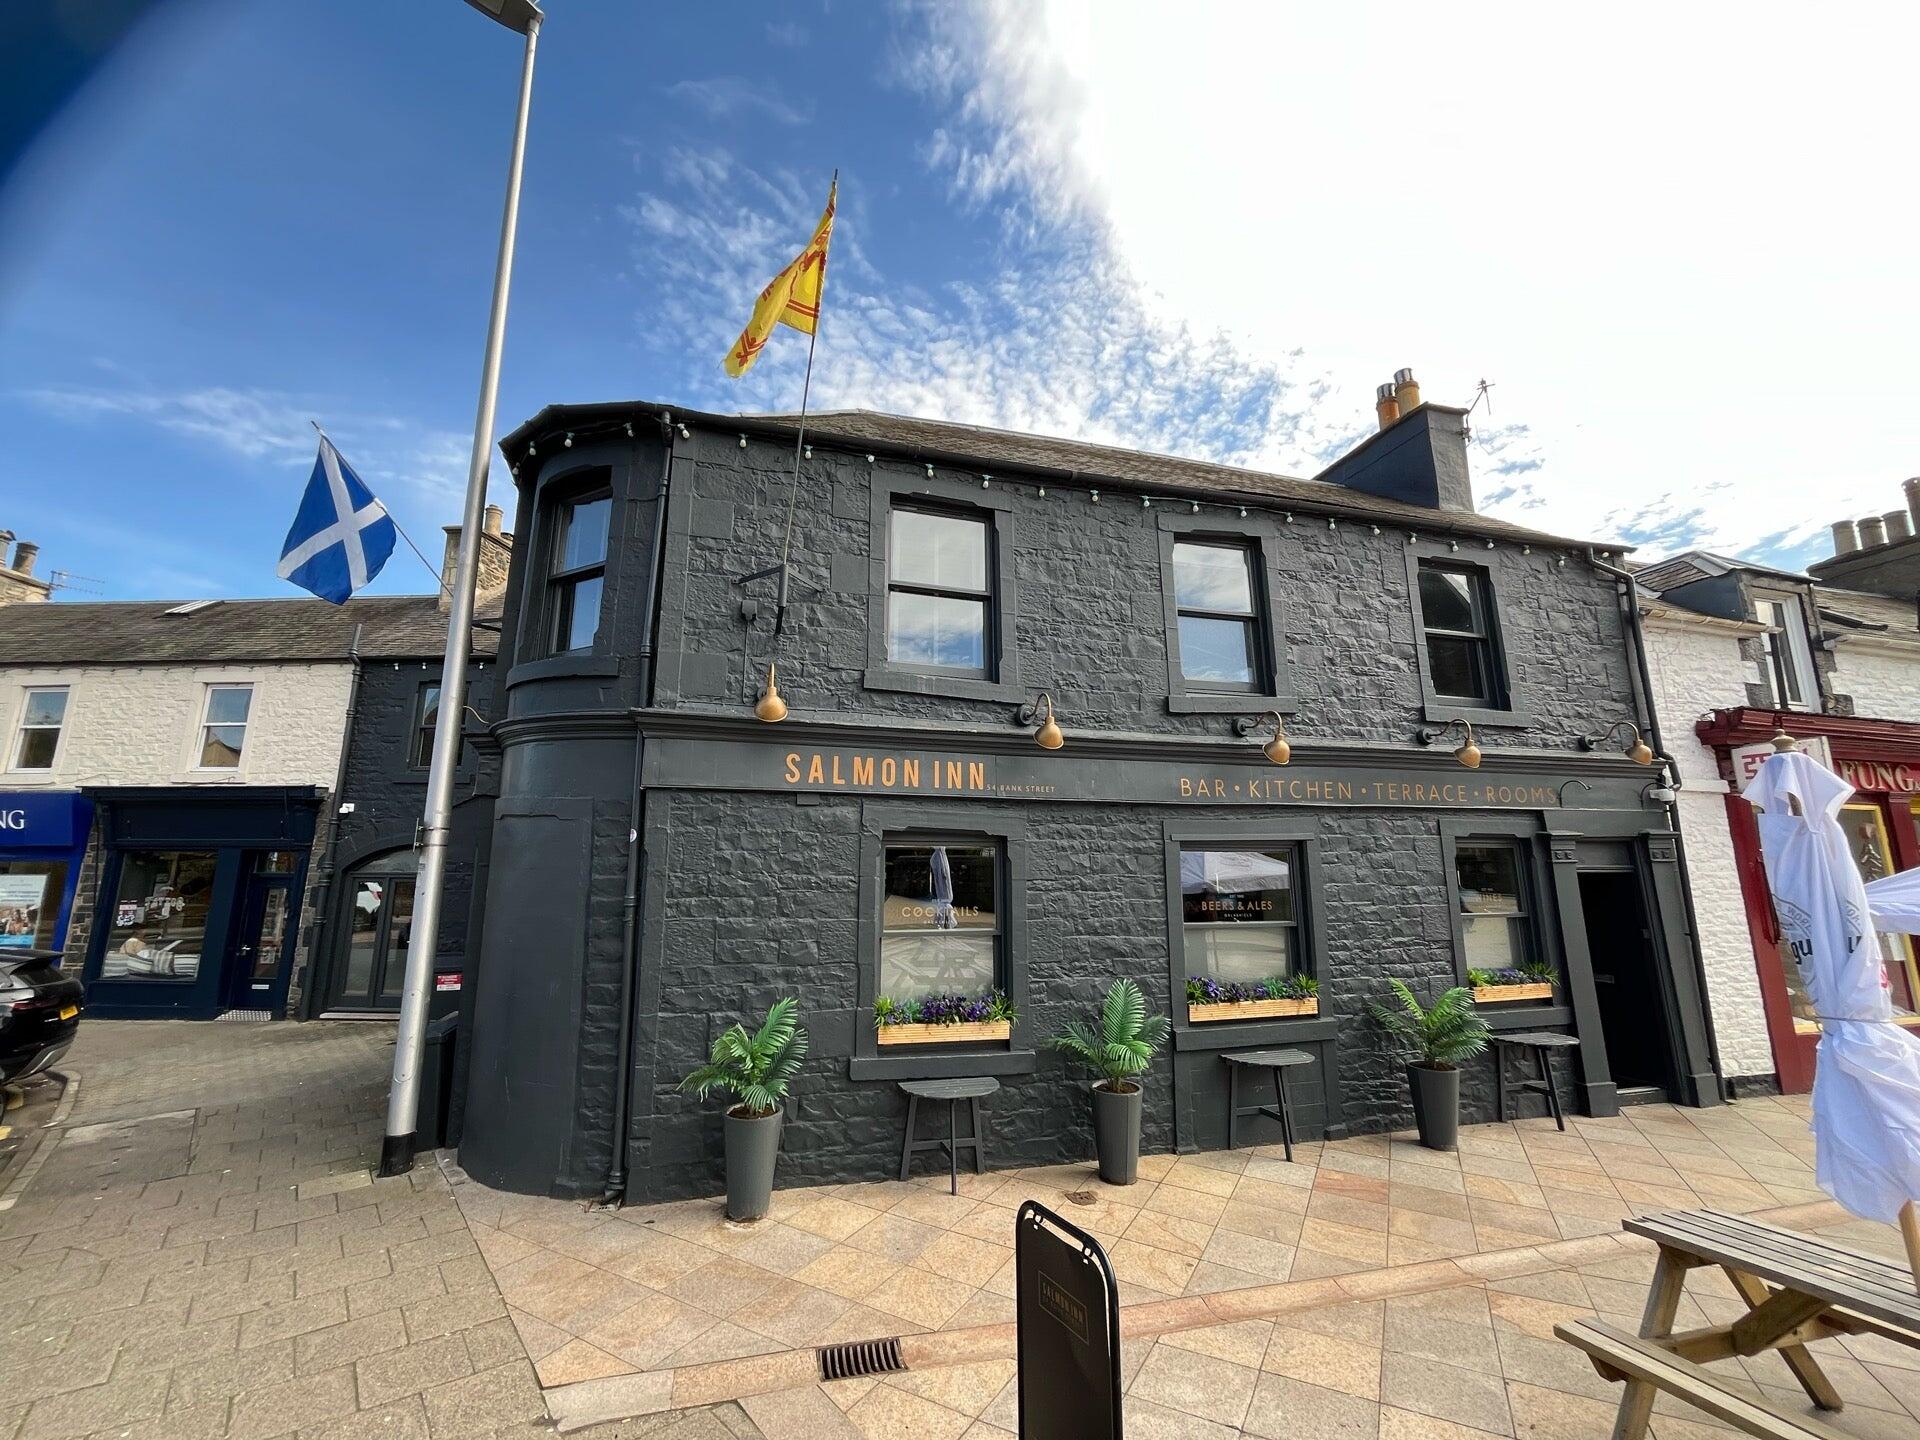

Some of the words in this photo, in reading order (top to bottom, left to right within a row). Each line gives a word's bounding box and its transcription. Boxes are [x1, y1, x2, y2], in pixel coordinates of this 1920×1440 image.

[784, 752, 920, 788] SALMON
[933, 759, 985, 791] INN
[1837, 759, 1914, 791] FUNG
[986, 783, 996, 791] 54
[1000, 784, 1023, 792] BANK
[1024, 785, 1056, 793] STREET
[1180, 778, 1226, 797] BAR
[1249, 779, 1352, 799] KITCHEN
[1372, 782, 1468, 802] TERRACE
[1486, 785, 1556, 804] ROOMS
[1201, 901, 1235, 911] BEERS
[1237, 901, 1245, 911] &
[1247, 900, 1273, 911] ALES
